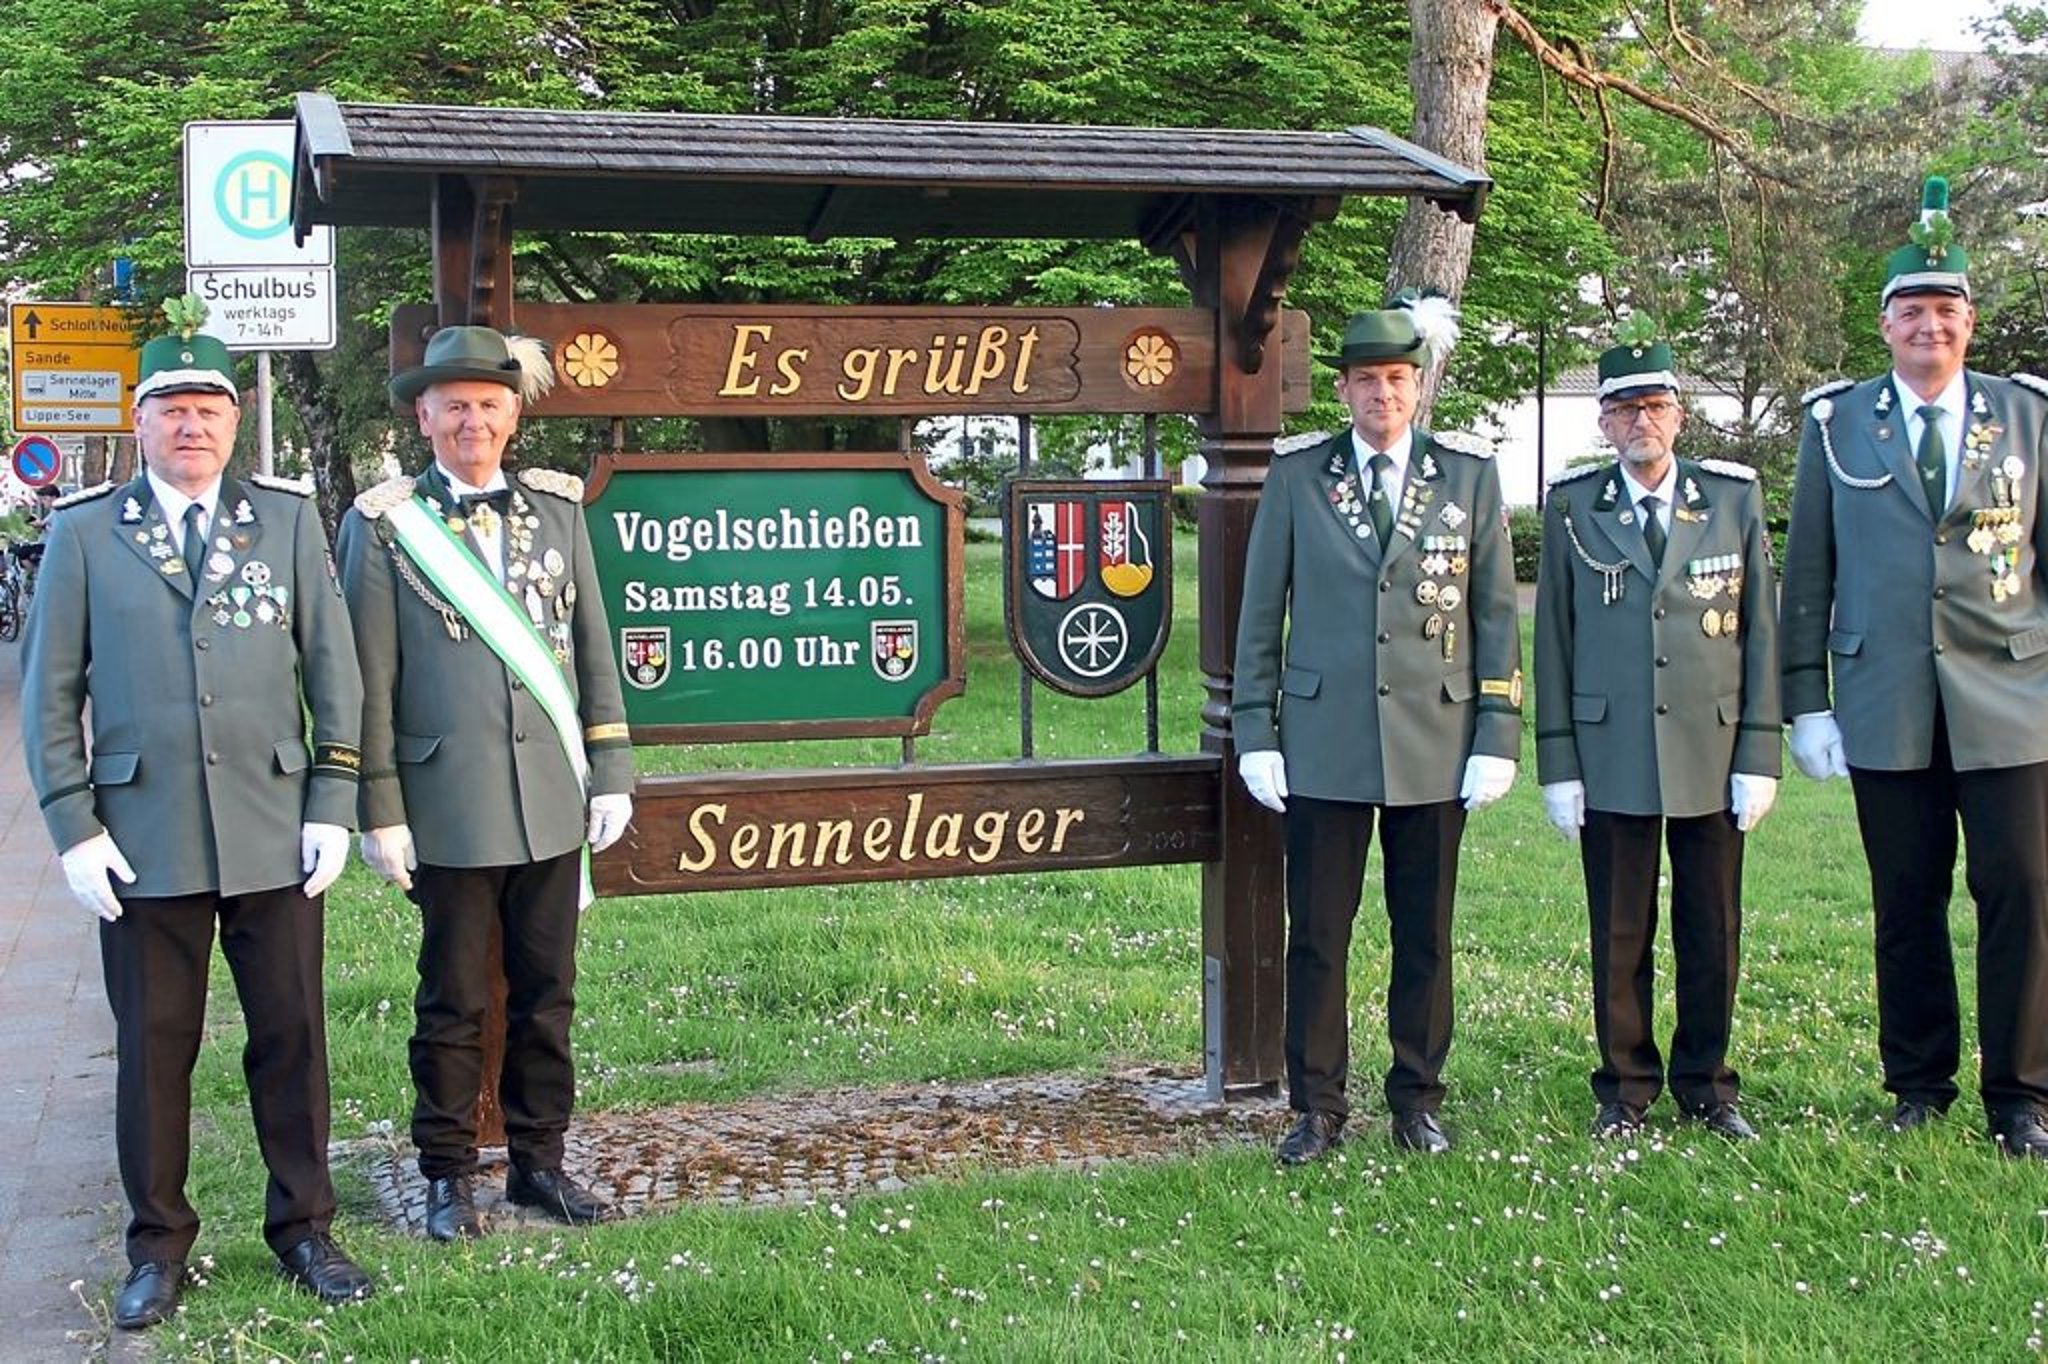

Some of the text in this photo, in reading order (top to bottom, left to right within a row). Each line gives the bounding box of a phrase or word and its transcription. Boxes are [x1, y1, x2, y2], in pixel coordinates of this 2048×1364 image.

[241, 170, 277, 219] H
[204, 278, 316, 300] Schulbus
[224, 306, 296, 322] werktags
[26, 352, 71, 364] Sande
[719, 325, 1038, 401] Es grüßt
[49, 374, 117, 387] Sennelager
[69, 389, 97, 399] Mitte
[26, 411, 91, 422] Lippe-See
[614, 507, 923, 562] Vogelschießen
[625, 576, 914, 615] Samstag 14.05.
[682, 636, 861, 671] 16.00 Uhr
[679, 794, 1085, 874] Sennelager
